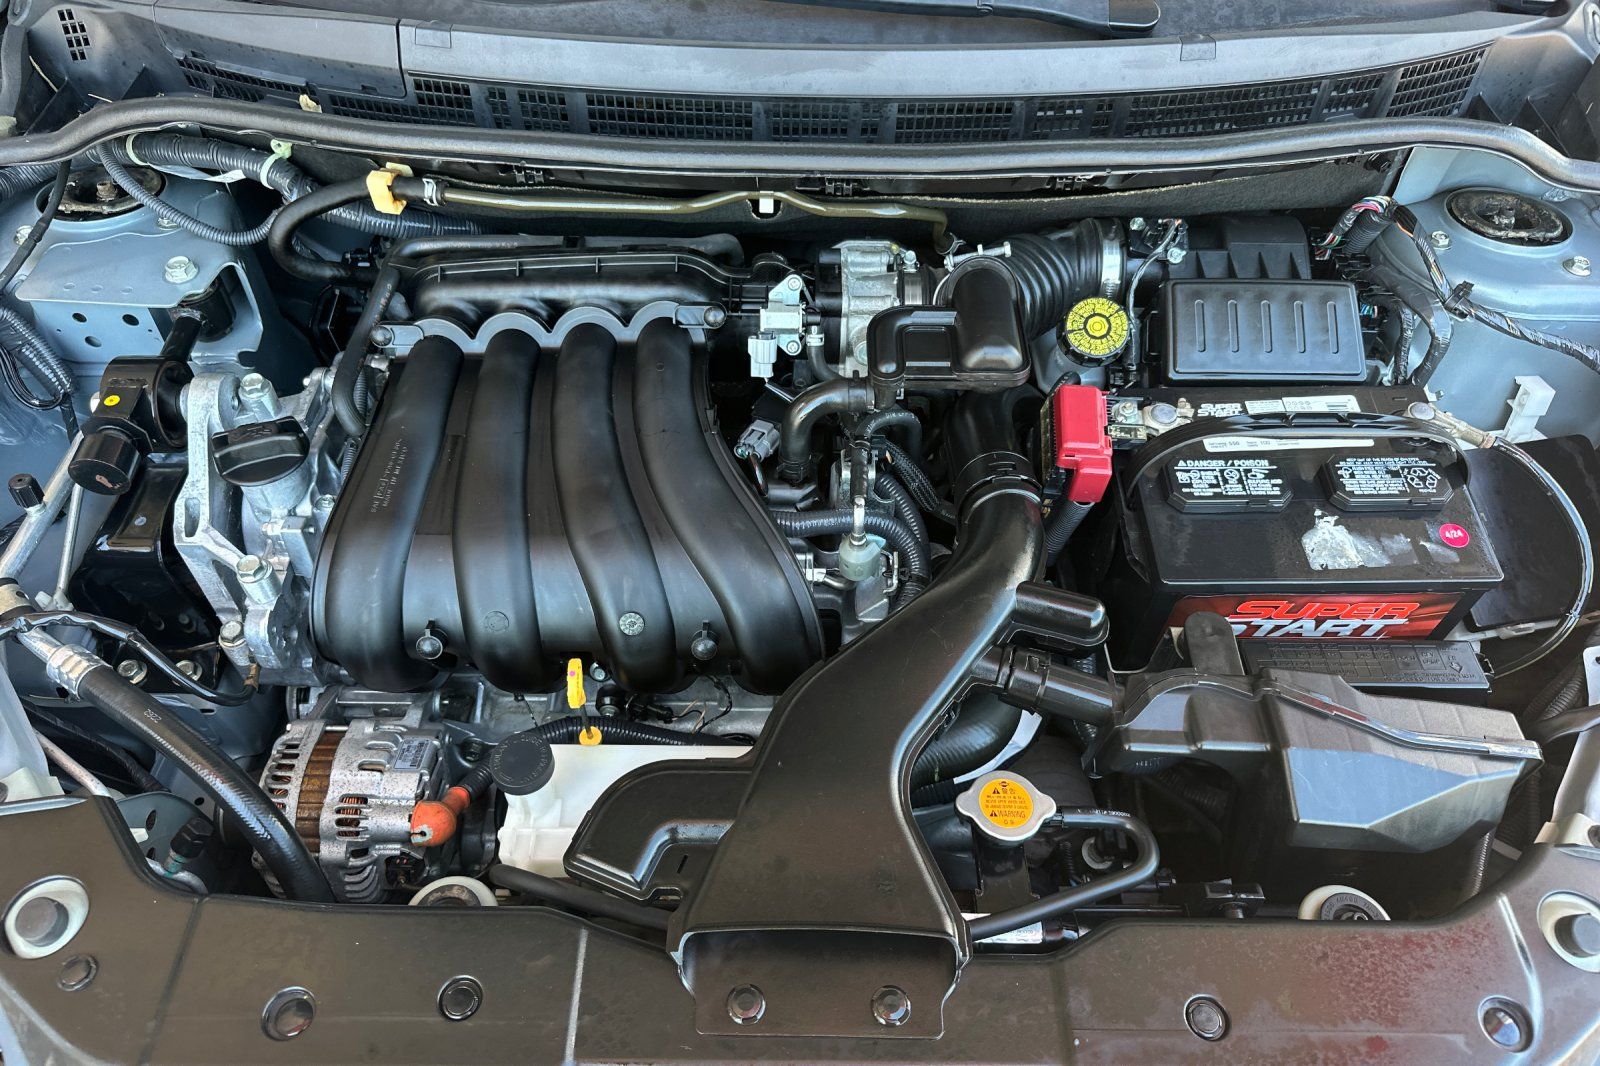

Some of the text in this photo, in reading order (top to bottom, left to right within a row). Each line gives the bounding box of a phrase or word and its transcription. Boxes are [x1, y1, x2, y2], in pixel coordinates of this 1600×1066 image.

[1200, 403, 1242, 411] SUPER
[1228, 600, 1420, 619] SUPER
[998, 810, 1026, 818] WARNING
